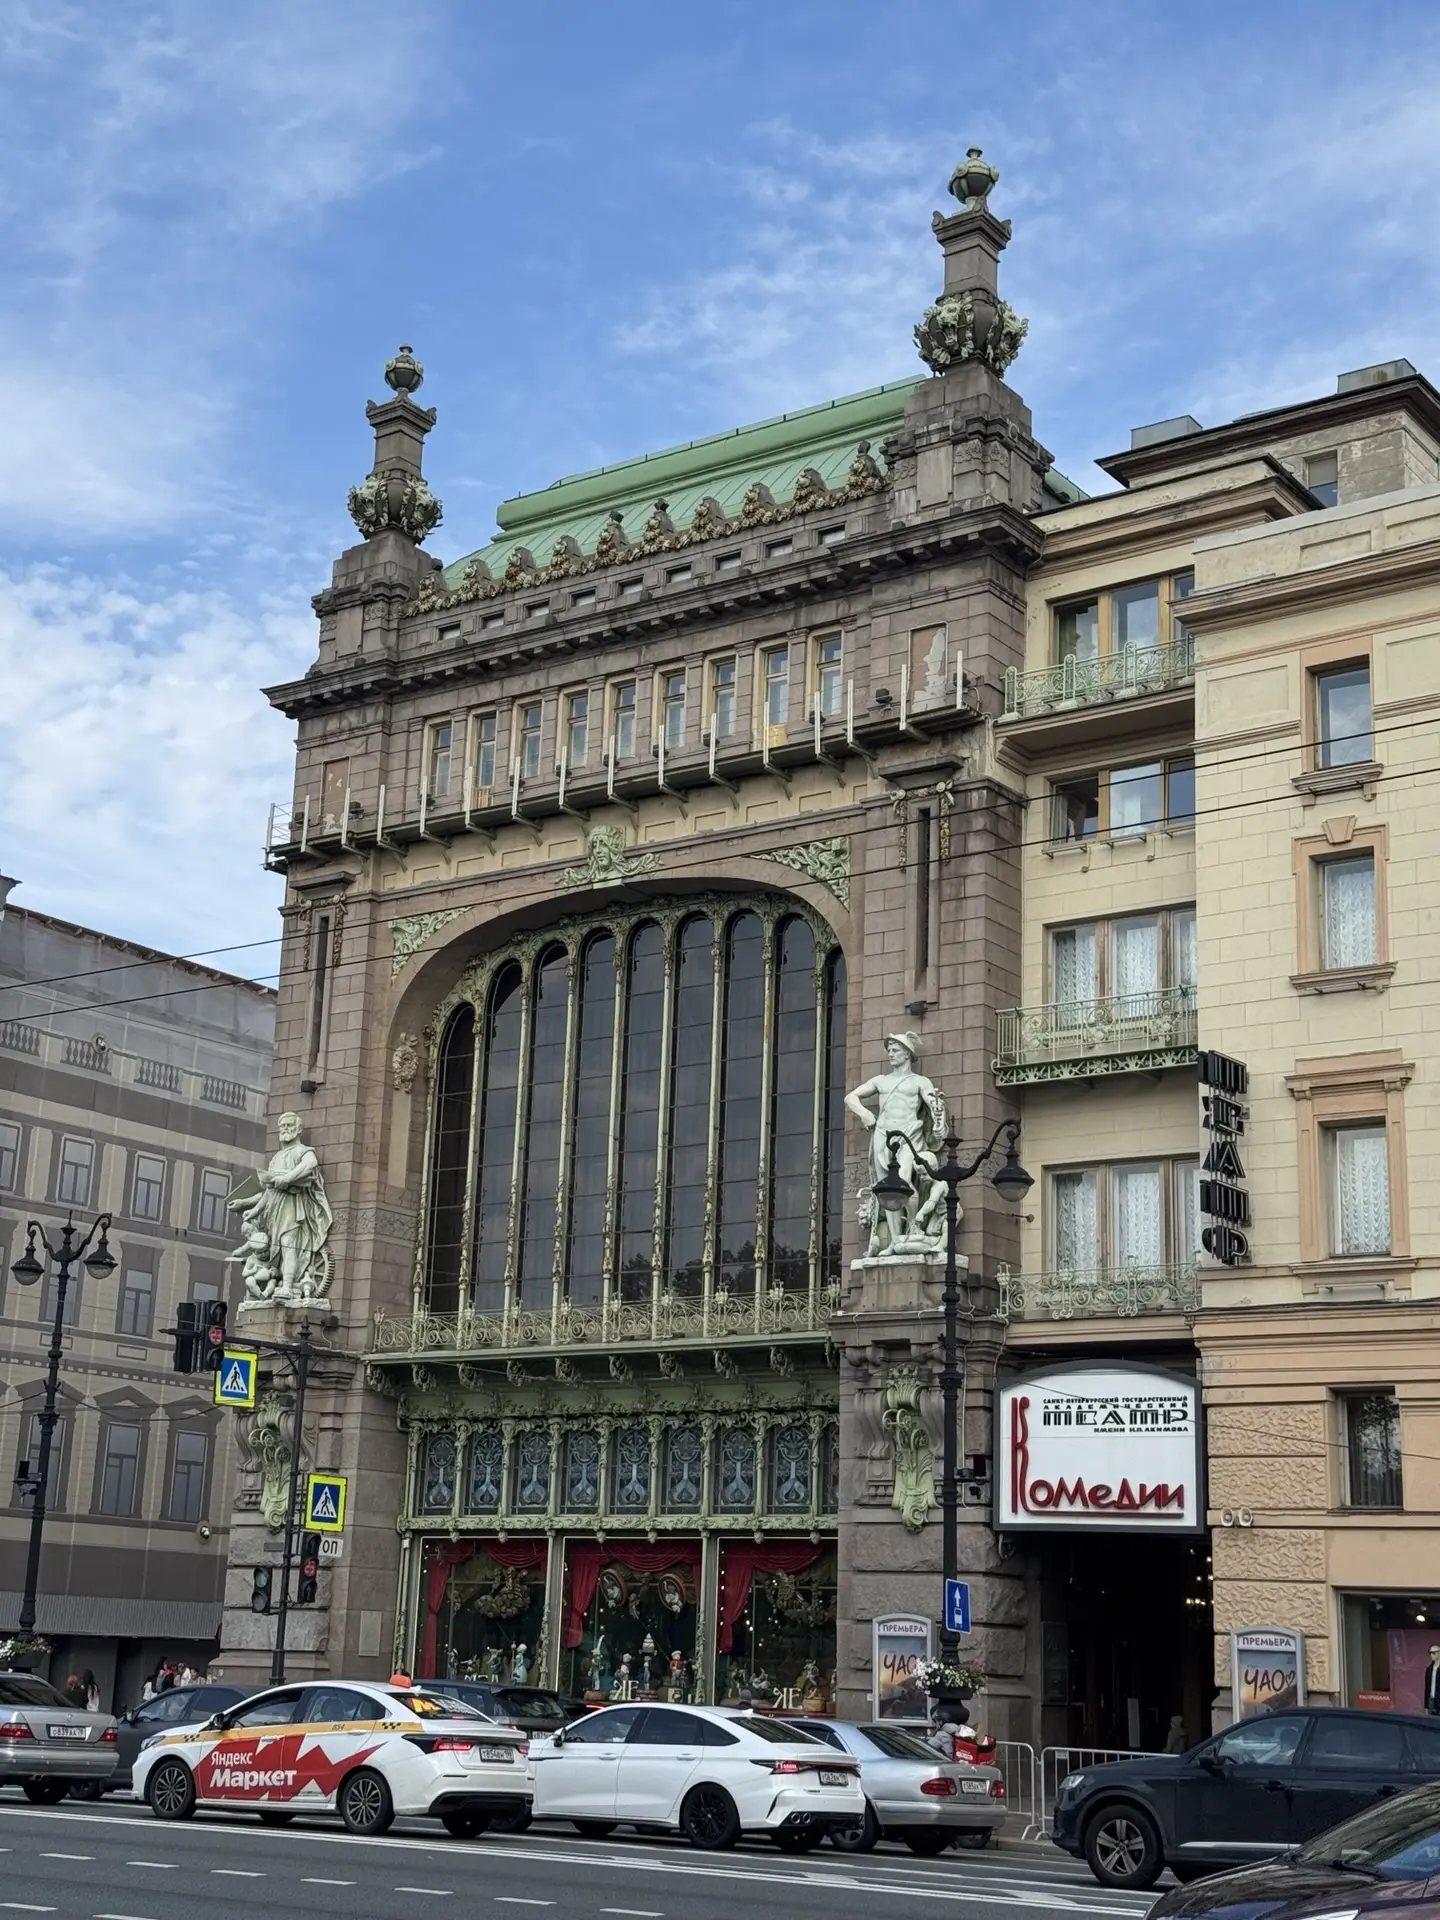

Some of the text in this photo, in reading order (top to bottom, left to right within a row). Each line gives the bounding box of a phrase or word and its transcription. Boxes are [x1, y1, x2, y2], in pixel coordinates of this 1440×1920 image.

[882, 1624, 924, 1633] ПРЕМЬЕРА
[1242, 1636, 1292, 1648] ПРЕМЬЕРА
[1244, 1668, 1285, 1700] ЧАО
[210, 1751, 253, 1766] Яндекс
[209, 1768, 298, 1790] Маркет
